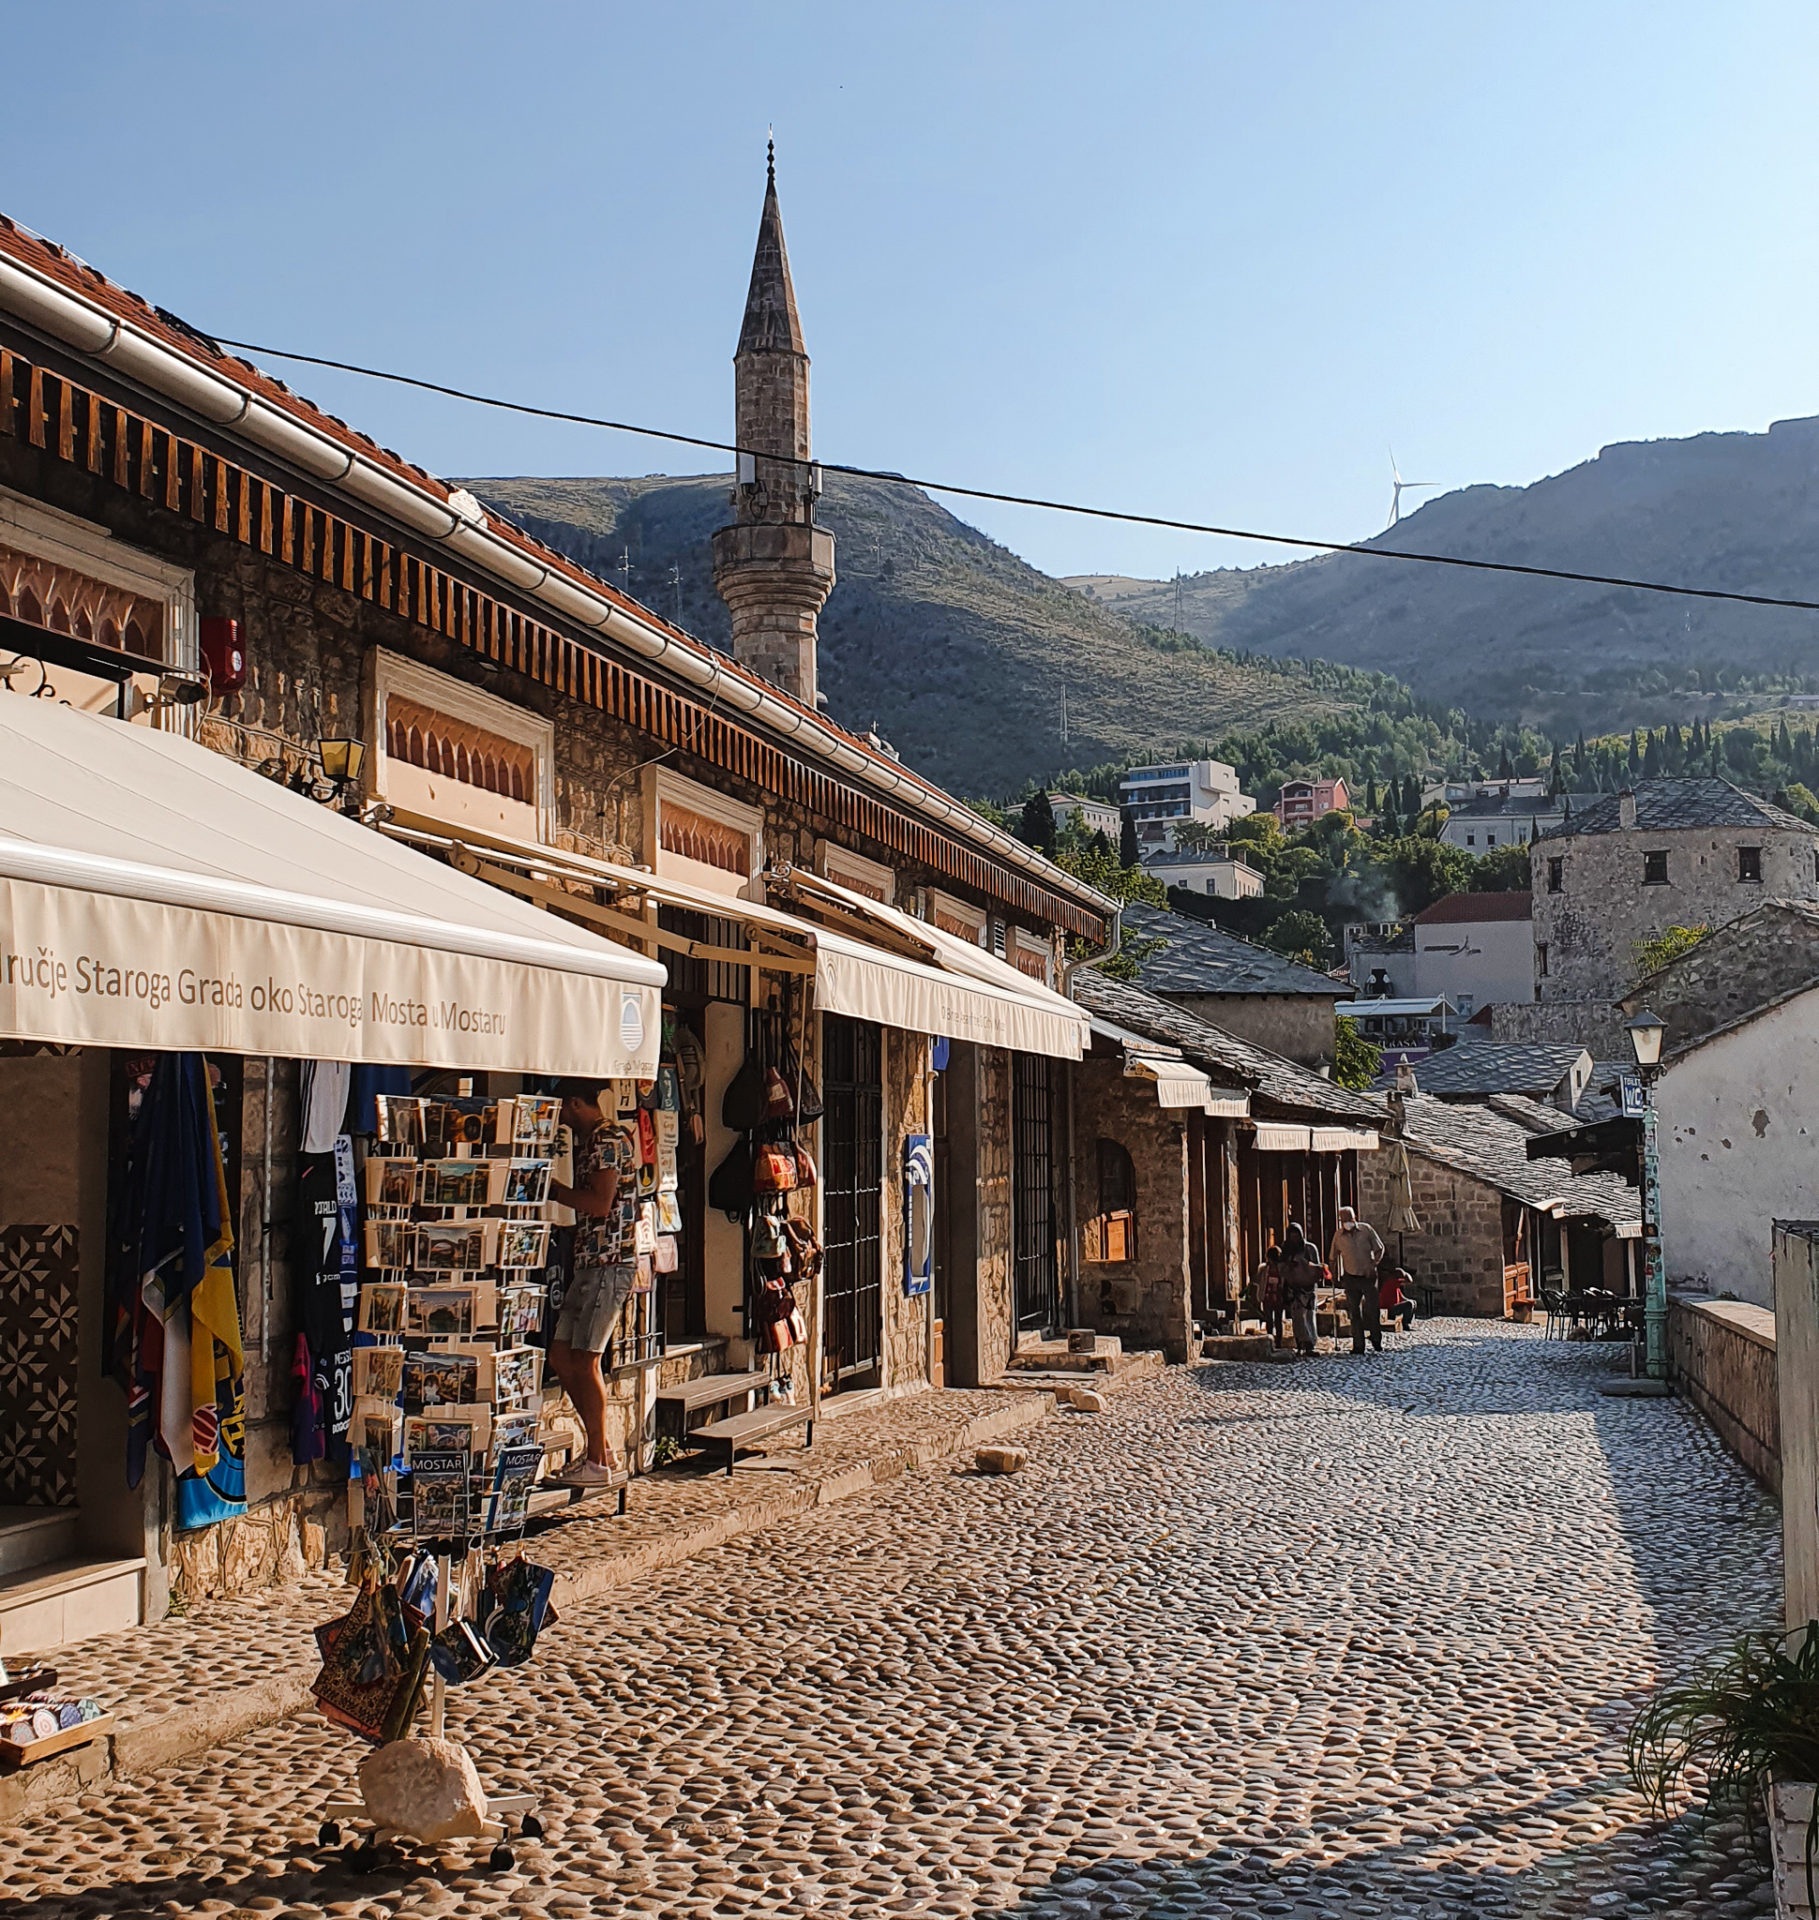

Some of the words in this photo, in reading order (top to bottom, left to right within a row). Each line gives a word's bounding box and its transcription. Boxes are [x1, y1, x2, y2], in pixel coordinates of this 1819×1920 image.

[0, 943, 67, 998] ručje
[75, 956, 170, 1009] Staroga
[178, 969, 243, 1009] Grada
[250, 977, 293, 1013] oko
[297, 983, 362, 1028] Staroga
[372, 992, 427, 1026] Mosta
[440, 1000, 506, 1035] Mostaru
[1625, 1086, 1643, 1106] WC
[322, 1217, 337, 1266] 7
[333, 1365, 353, 1421] 30
[412, 1459, 463, 1471] MOSTAR
[504, 1453, 541, 1466] MOSTAR
